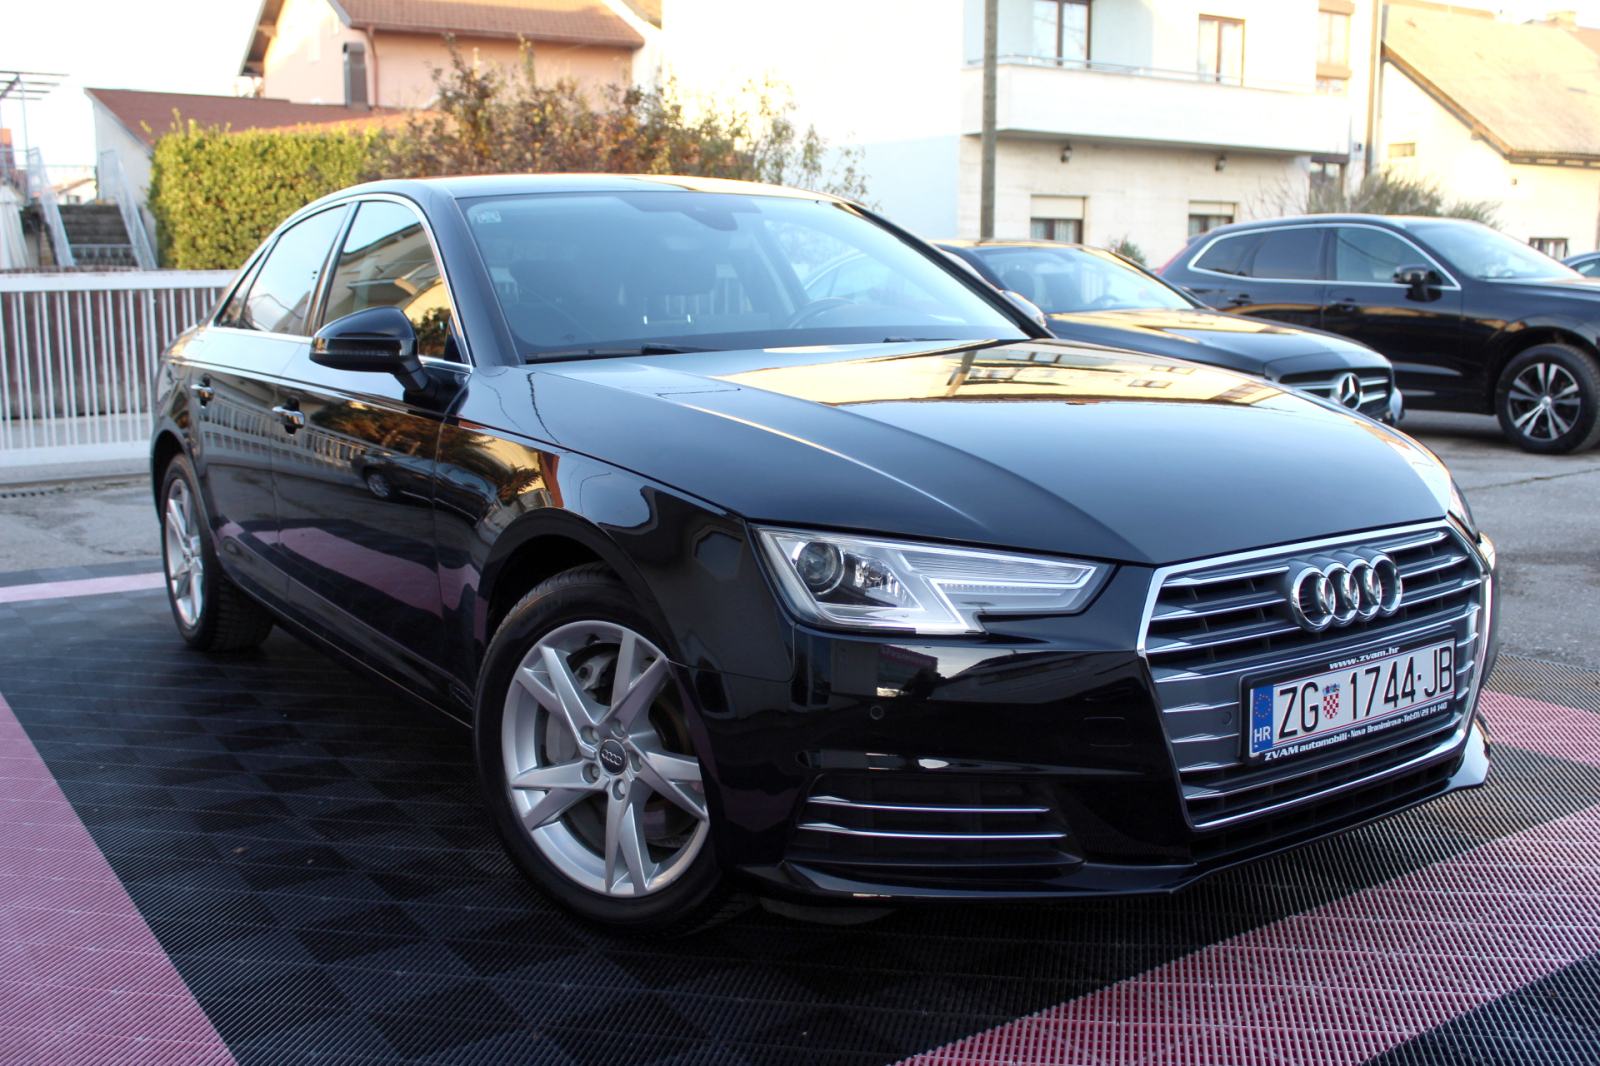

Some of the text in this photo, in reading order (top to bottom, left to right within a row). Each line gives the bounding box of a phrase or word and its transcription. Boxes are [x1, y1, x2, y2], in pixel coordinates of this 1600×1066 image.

[1329, 647, 1400, 669] www.zvam.hr
[1279, 681, 1319, 739] ZG
[1254, 726, 1271, 743] HR
[1265, 745, 1298, 761] ZVAM
[1300, 732, 1347, 752] automobili
